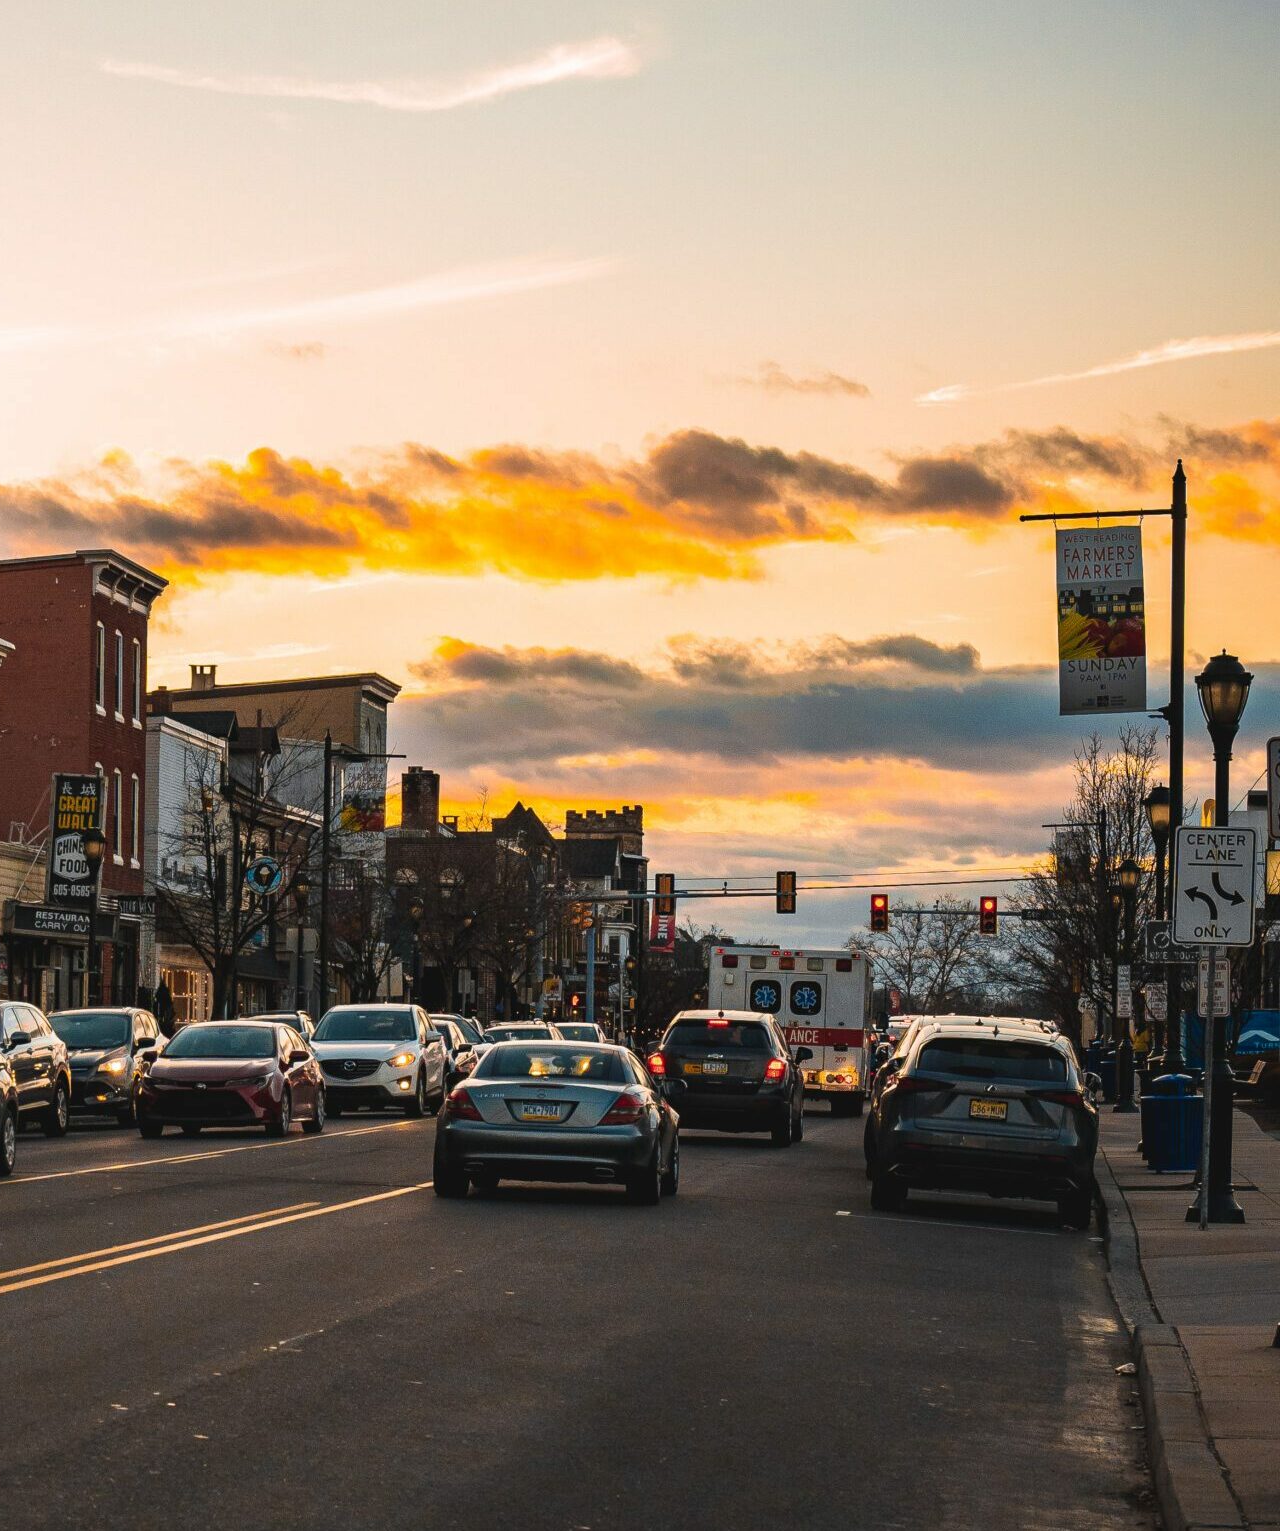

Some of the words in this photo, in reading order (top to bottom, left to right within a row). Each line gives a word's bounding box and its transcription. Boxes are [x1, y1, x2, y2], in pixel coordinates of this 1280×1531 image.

[1064, 534, 1090, 544] WEST
[1094, 533, 1135, 542] READING
[1067, 562, 1132, 580] MARKET
[1068, 658, 1138, 674] SUNDAY
[59, 796, 97, 813] GREAT
[58, 813, 95, 830] WALL
[1187, 834, 1246, 846] CENTER
[1195, 850, 1236, 860] LANE
[60, 860, 88, 873] FOOD
[36, 911, 90, 923] RESTAURAN
[34, 921, 68, 930] CARRY
[1194, 926, 1232, 938] ONLY
